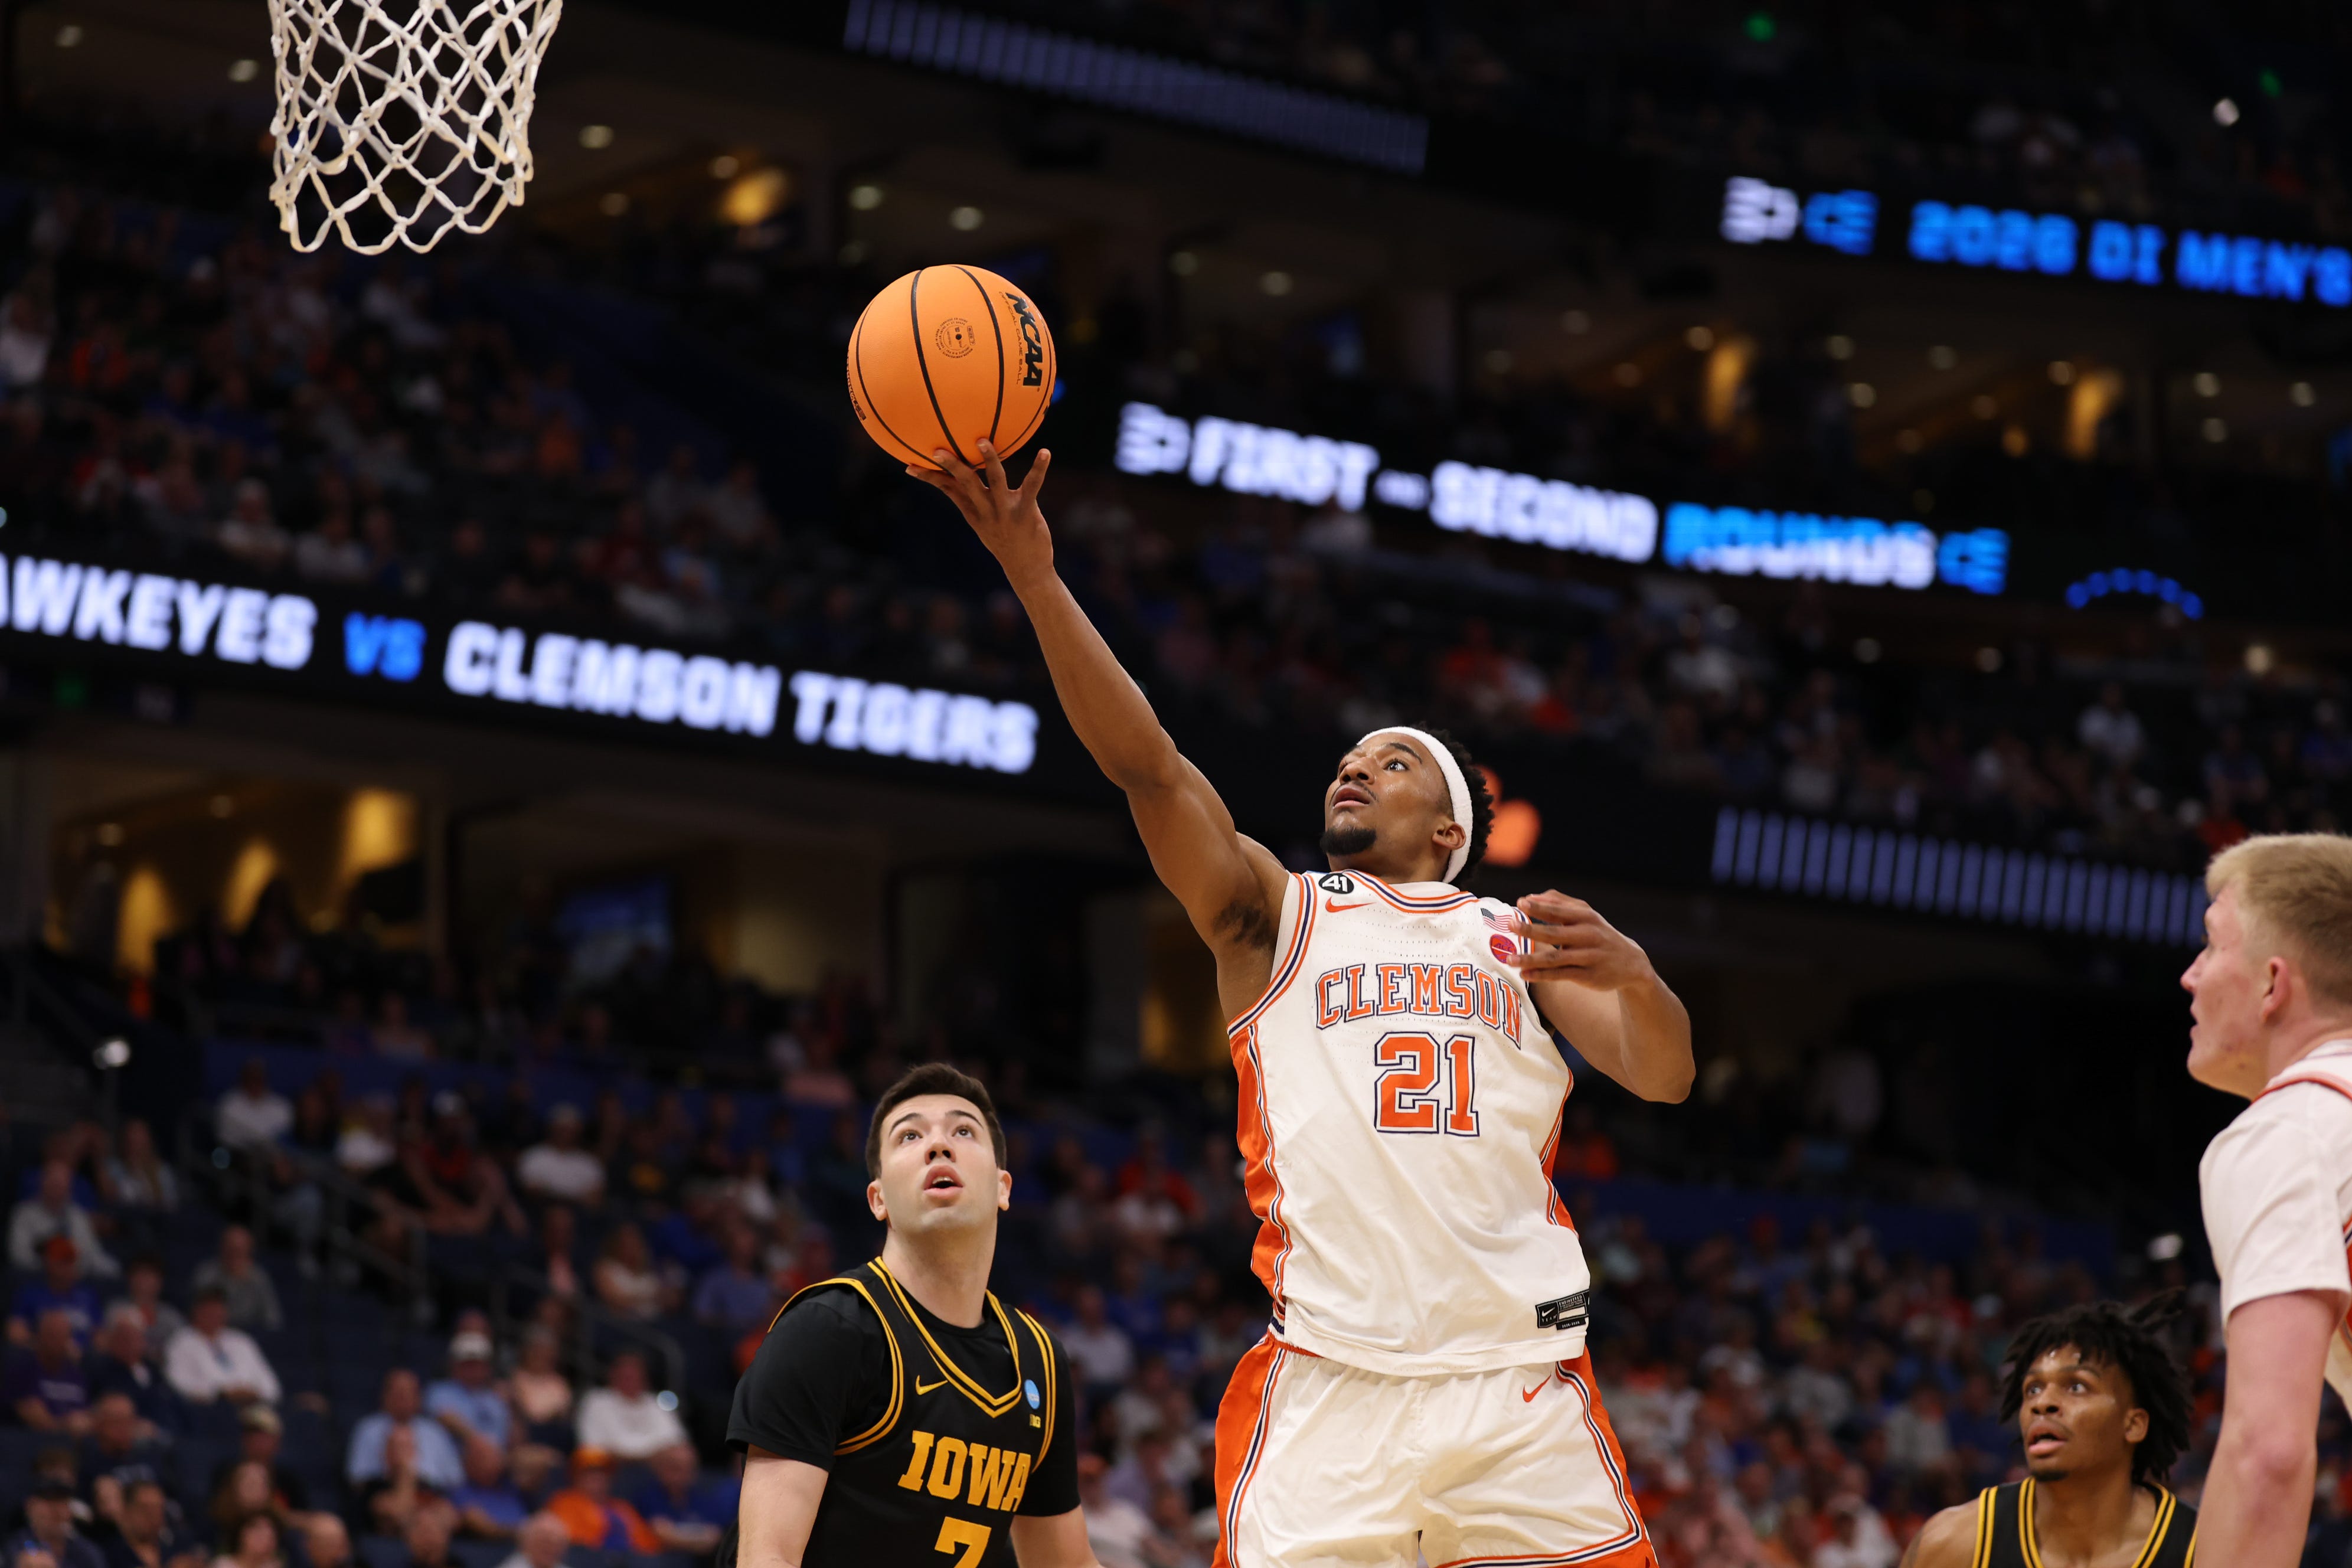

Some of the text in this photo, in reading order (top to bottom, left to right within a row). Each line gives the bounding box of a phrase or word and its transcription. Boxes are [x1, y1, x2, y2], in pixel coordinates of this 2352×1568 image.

[1908, 200, 2352, 308] 2026 DI MEN'S
[999, 291, 1017, 325] OFFICIAL
[1005, 292, 1043, 386] NCAA
[1189, 414, 1379, 512] FIRST
[1428, 459, 1660, 564] SECOND
[1662, 501, 1937, 590] ROUNDS
[0, 552, 1041, 775] WKEYES VS CLEMSON TIGERS
[1322, 875, 1348, 893] 41
[1315, 963, 1521, 1050] CLEMSON
[1374, 1031, 1480, 1137] 21
[898, 1430, 1031, 1513] IOWA
[934, 1516, 992, 1568] 7
